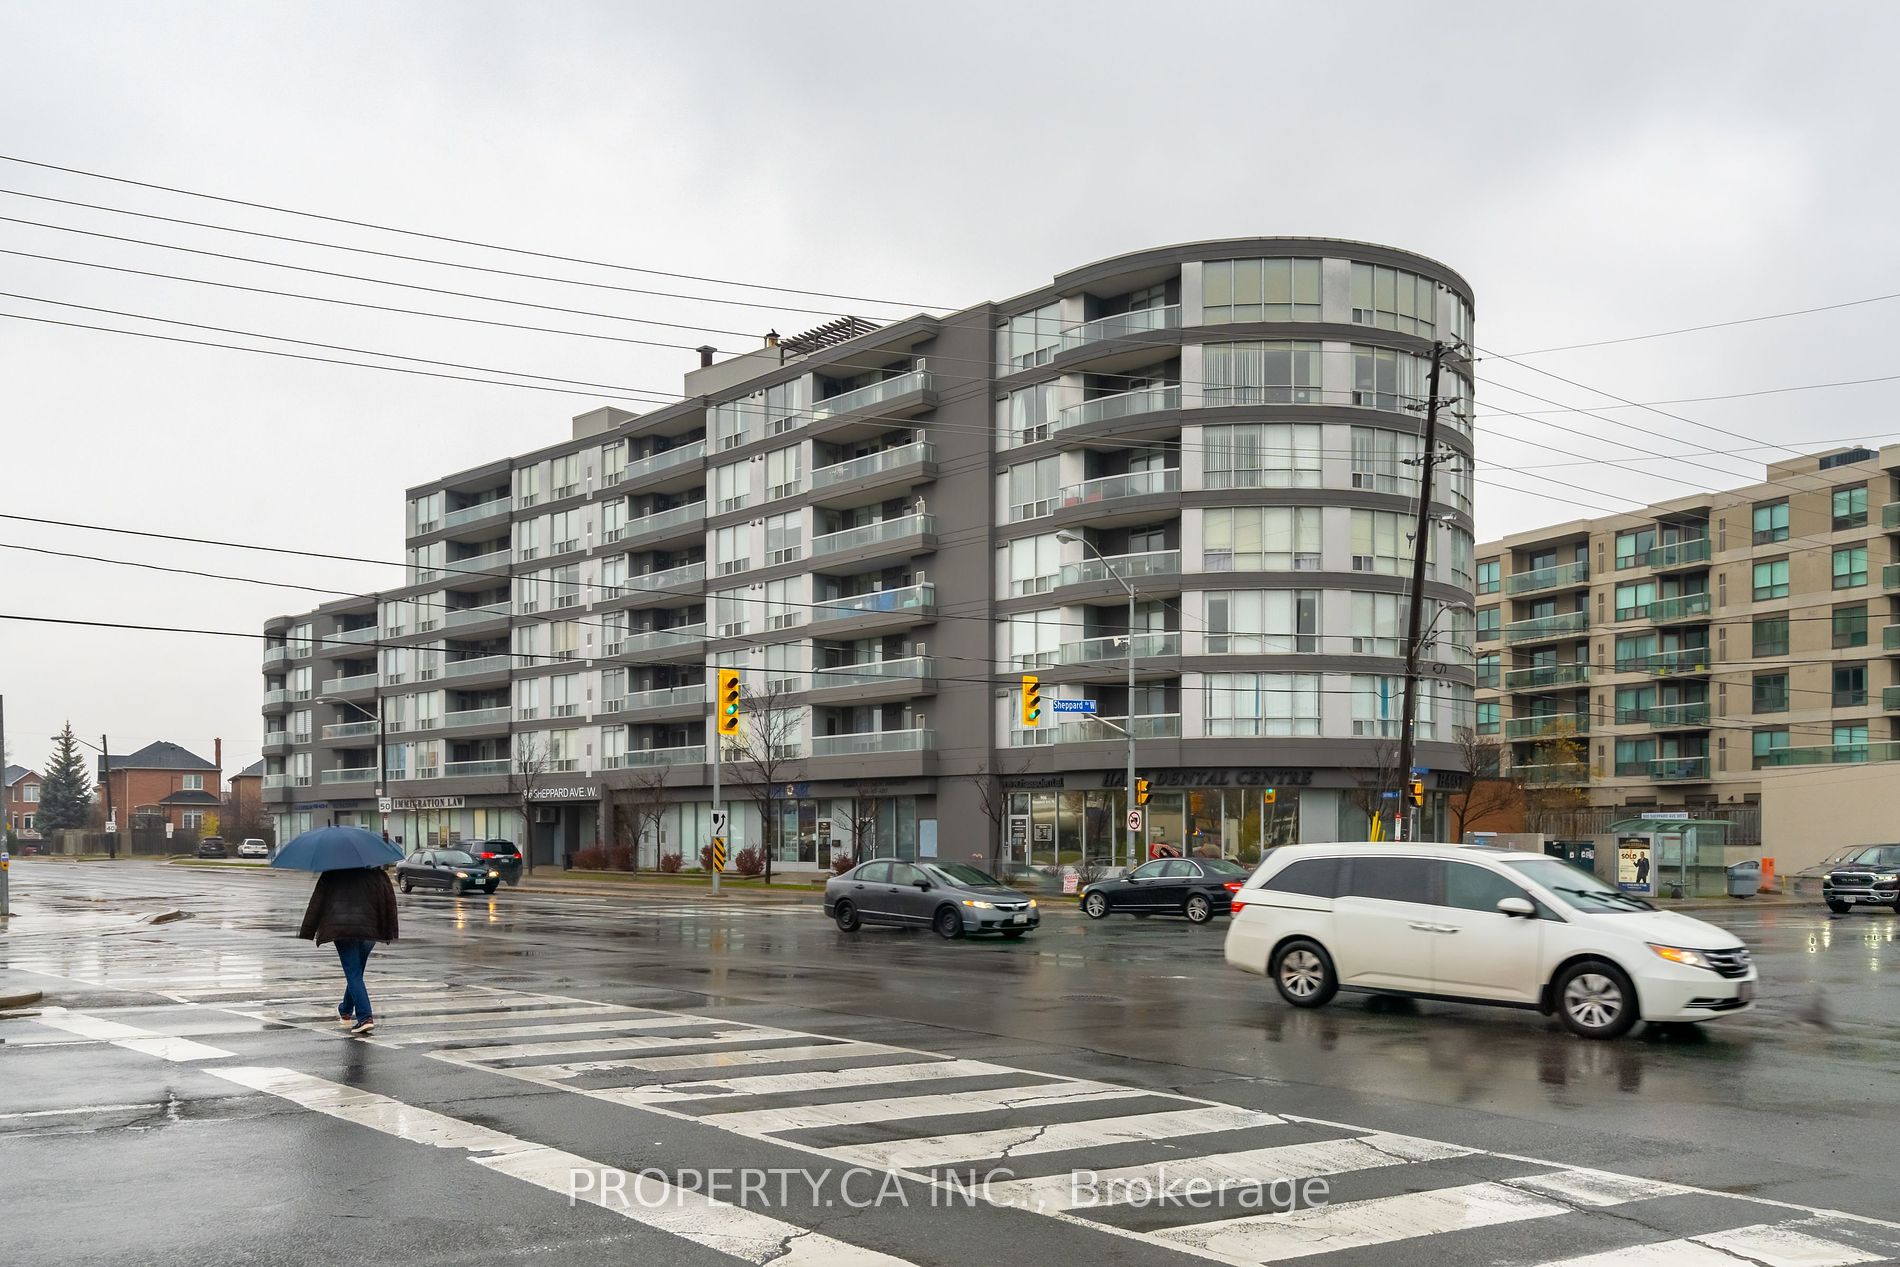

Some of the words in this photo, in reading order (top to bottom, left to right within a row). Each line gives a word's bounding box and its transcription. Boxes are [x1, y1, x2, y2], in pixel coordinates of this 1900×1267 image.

[1053, 700, 1083, 711] Sheppard
[1090, 701, 1095, 709] W
[1154, 770, 1230, 786] DENTAL
[1236, 769, 1313, 786] CENTRE
[533, 787, 569, 799] SHEPPARD
[569, 786, 587, 797] AVE.
[587, 786, 598, 797] W.
[380, 803, 391, 811] 50
[394, 799, 445, 809] IMMIGRATION
[447, 797, 464, 807] LAW
